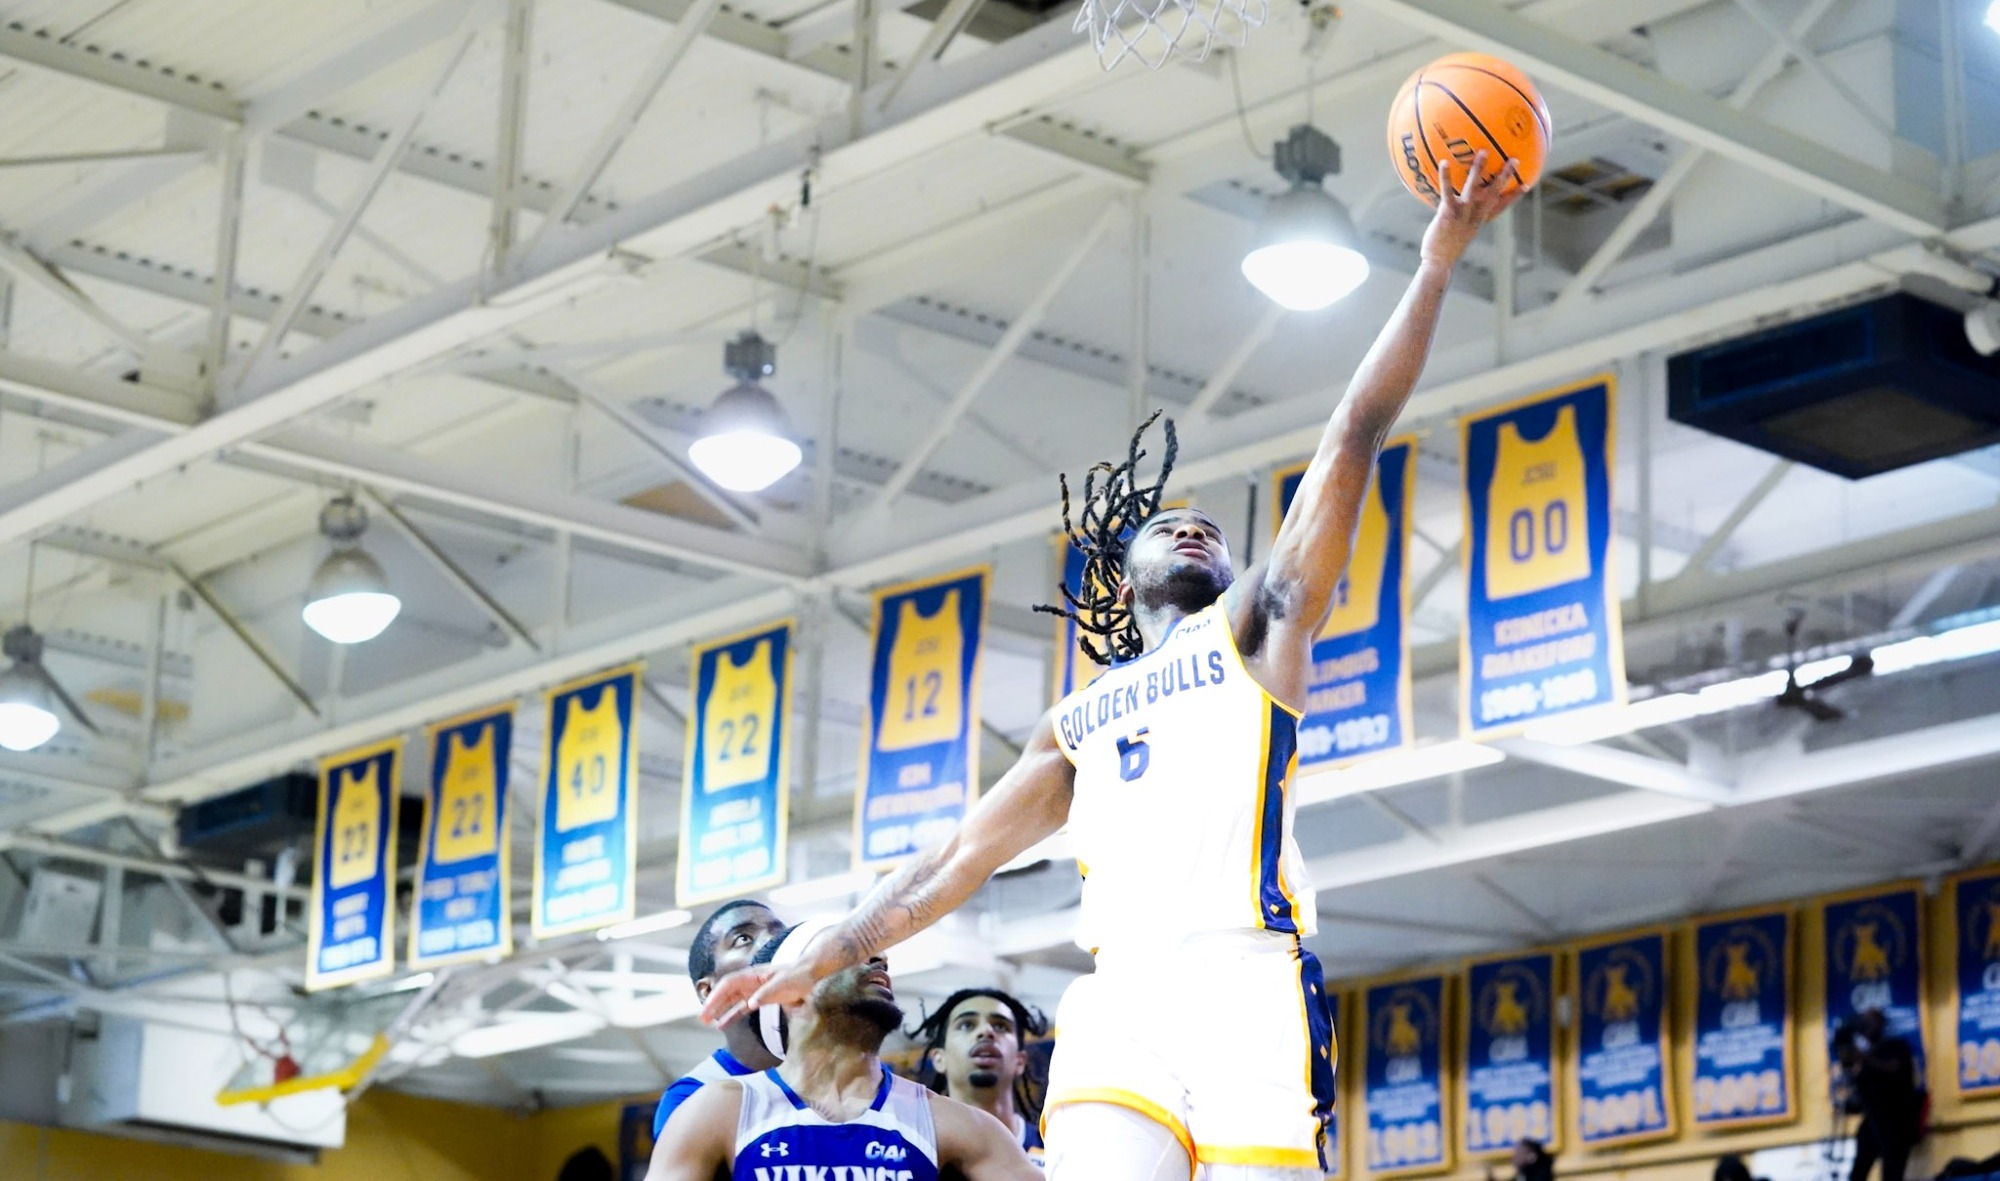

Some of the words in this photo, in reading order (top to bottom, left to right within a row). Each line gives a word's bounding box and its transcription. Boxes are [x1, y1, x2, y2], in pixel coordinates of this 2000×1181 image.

[1510, 499, 1568, 563] 00
[903, 670, 942, 722] 12
[1061, 680, 1139, 750] GOLDEN
[1147, 650, 1225, 704] BULLS
[719, 713, 760, 763] 22
[1116, 727, 1149, 782] 6
[571, 754, 605, 799] 40
